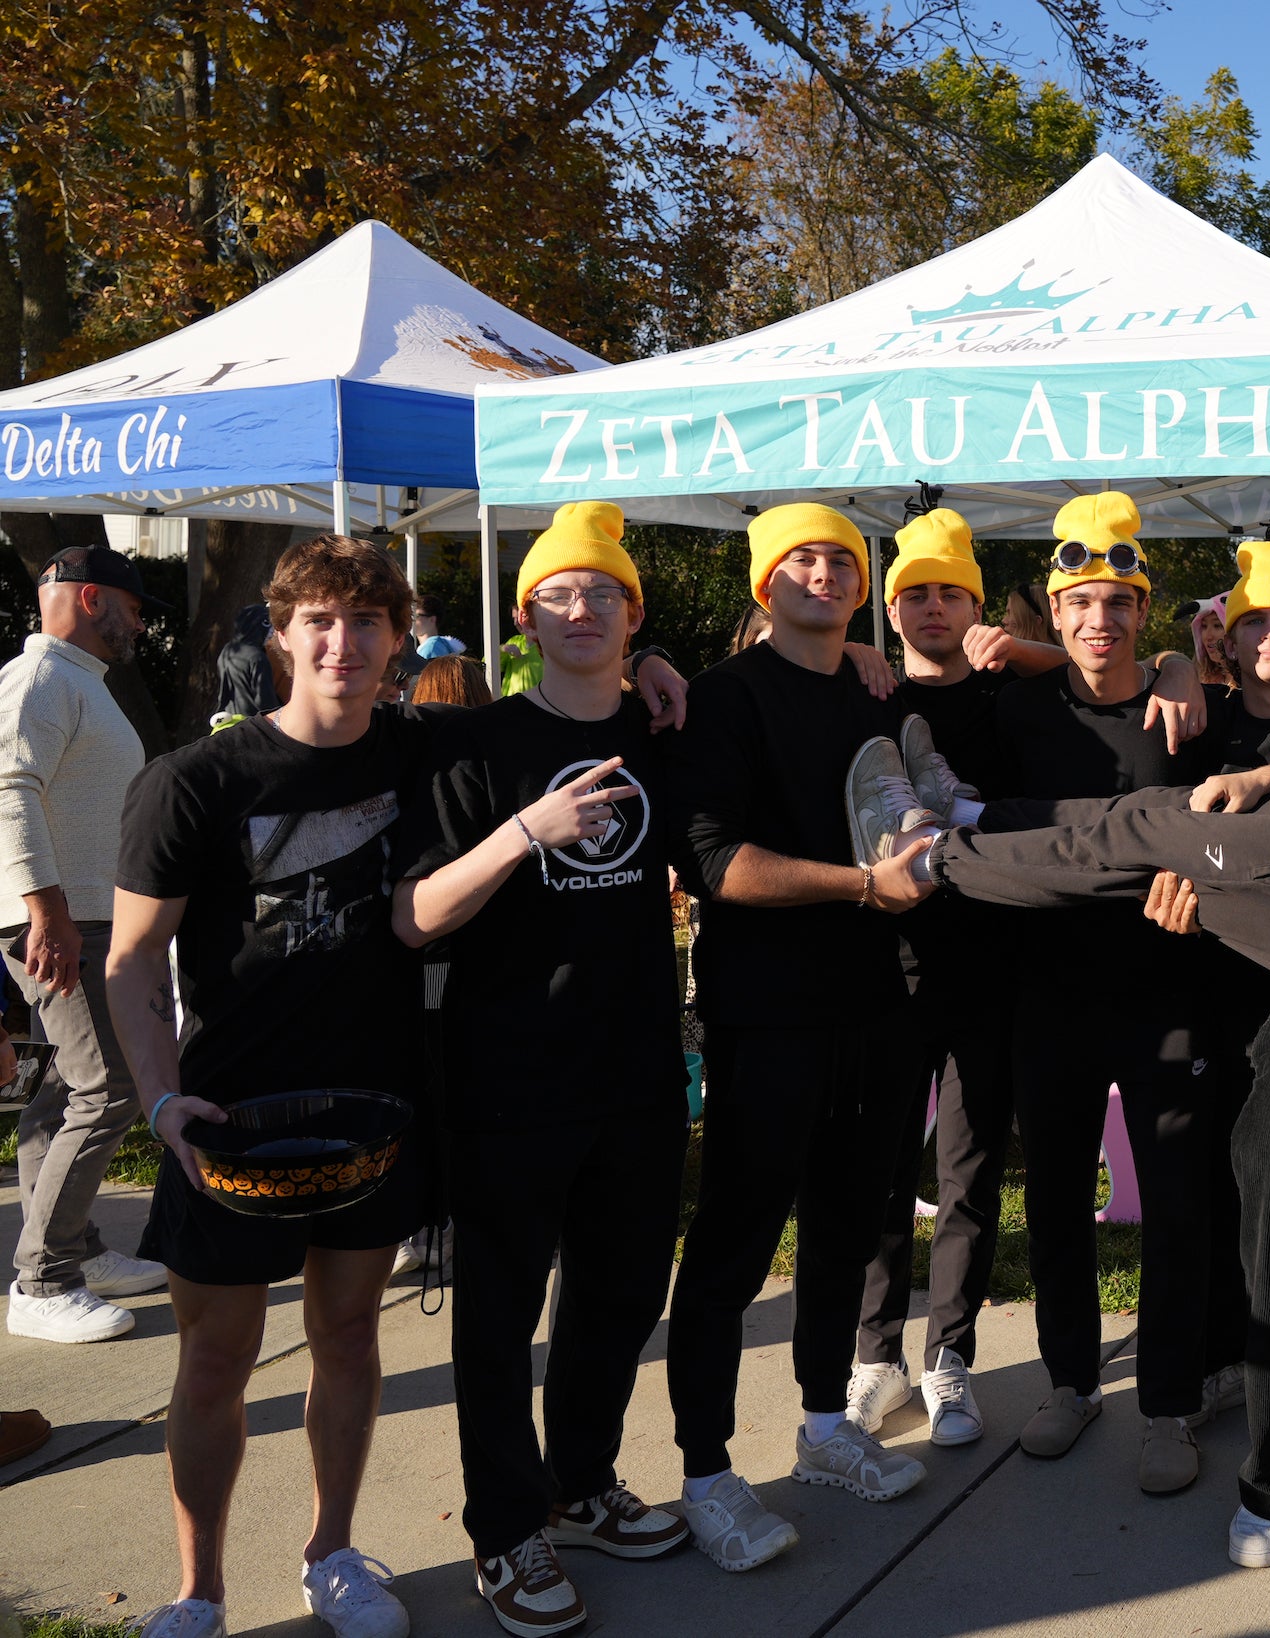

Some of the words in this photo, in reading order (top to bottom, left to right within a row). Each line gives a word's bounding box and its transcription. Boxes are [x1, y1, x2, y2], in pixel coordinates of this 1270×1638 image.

[874, 324, 1004, 351] TAU
[1021, 302, 1262, 336] ALPHA
[1, 412, 102, 481] Delta
[117, 404, 187, 475] Chi
[539, 409, 756, 483] ZETA
[778, 390, 973, 471] TAU
[361, 799, 395, 816] WALLE
[550, 868, 643, 891] VOLCOM
